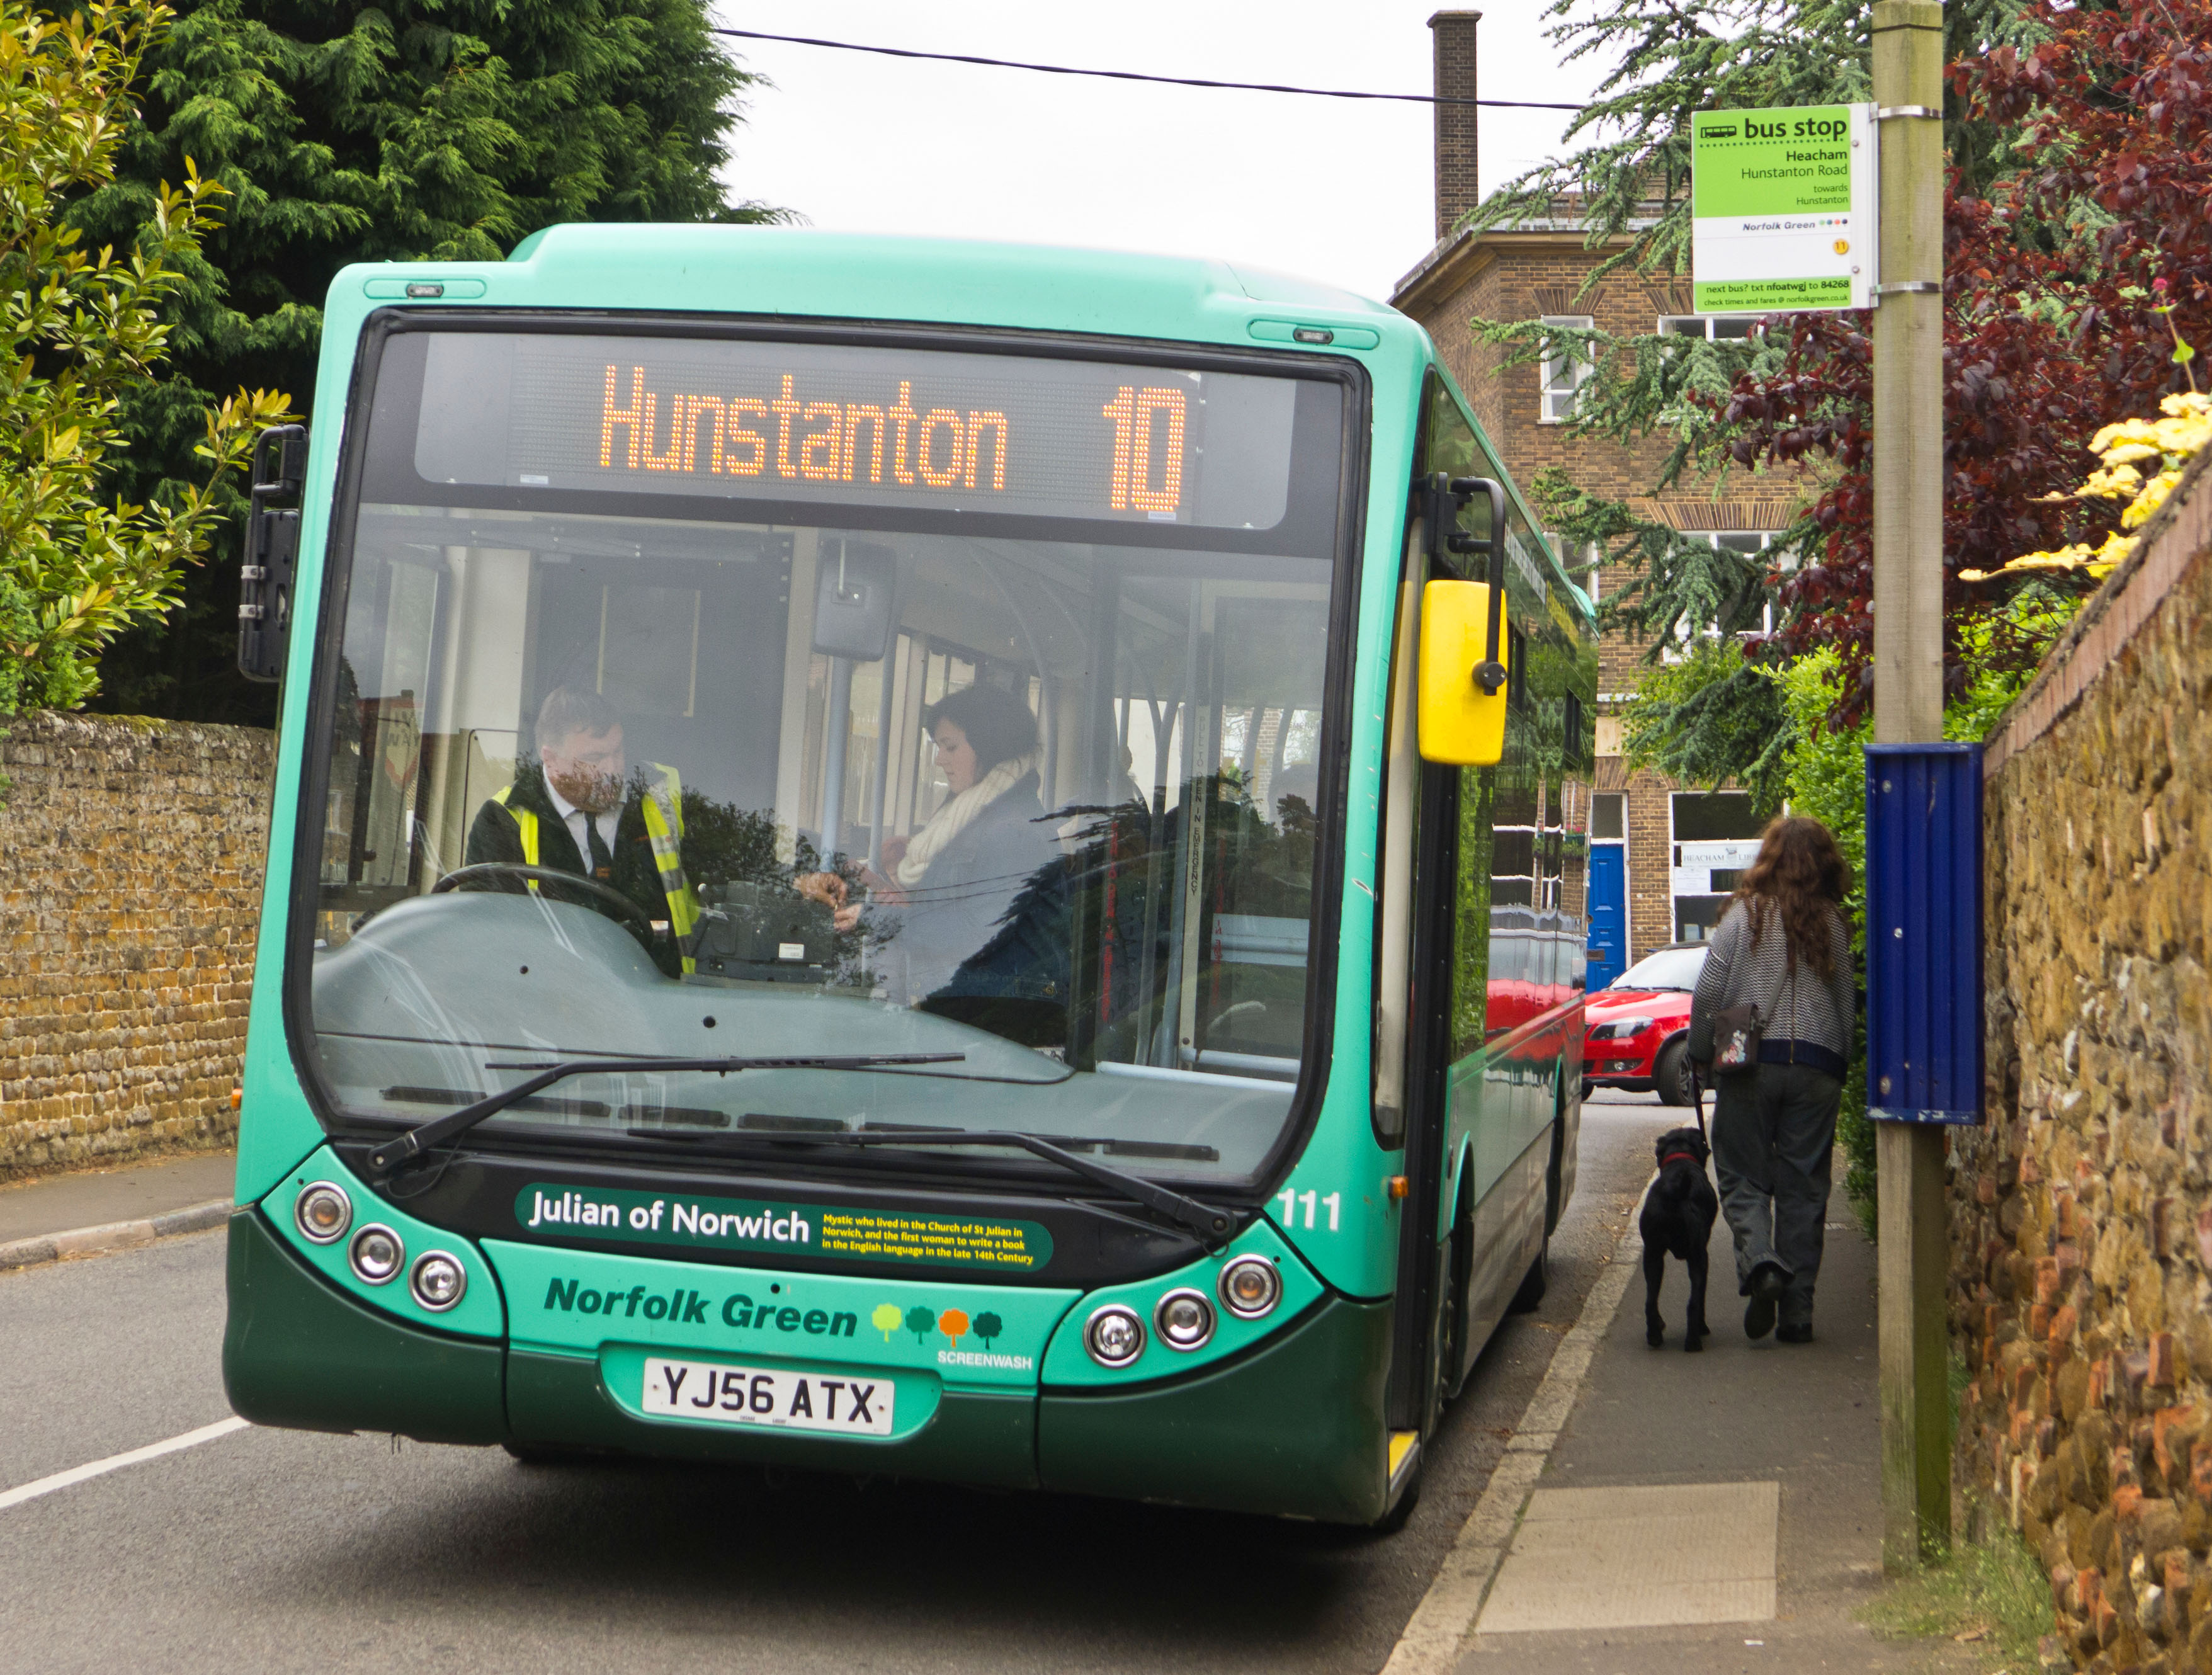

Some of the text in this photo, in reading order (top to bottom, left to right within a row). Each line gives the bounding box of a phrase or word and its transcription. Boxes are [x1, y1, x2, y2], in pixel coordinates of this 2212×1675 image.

[1745, 117, 1847, 142] bus stop
[1786, 149, 1847, 162] Heacham
[1742, 164, 1847, 179] Hunstanton Road
[1814, 184, 1848, 193] towards
[1796, 196, 1848, 205] Hunstanton
[1743, 221, 1815, 231] Norfolk Green
[1834, 242, 1846, 250] 11
[1706, 285, 1725, 293] next
[1728, 283, 1748, 292] bus?
[1766, 280, 1806, 292] nfoatwgj
[1704, 297, 1723, 306] check
[1725, 297, 1744, 305] times
[1786, 294, 1848, 303] norfolkgreen.co.uk
[601, 363, 1187, 512] Hunstanton 10
[1194, 807, 1201, 822] IN
[1191, 827, 1200, 895] EMERGENCY
[1683, 854, 1725, 862] HEACHAM
[529, 1190, 810, 1243] Julian of Norwich
[1277, 1188, 1341, 1232] 111
[824, 1214, 1023, 1237] Mystic who lived in the Church of St Julian in
[823, 1227, 863, 1239] Norwich,
[865, 1230, 881, 1239] and
[884, 1231, 898, 1241] the
[901, 1232, 919, 1242] first
[922, 1235, 954, 1244] woman
[957, 1236, 967, 1246] to
[969, 1237, 992, 1247] write
[1003, 1240, 1025, 1250] book
[822, 1239, 1033, 1266] in the English language in the late 14th Century
[543, 1277, 858, 1338] Norfolk Green
[938, 1351, 1033, 1370] SCREENWASH
[664, 1366, 875, 1424] YJ56 ATX
